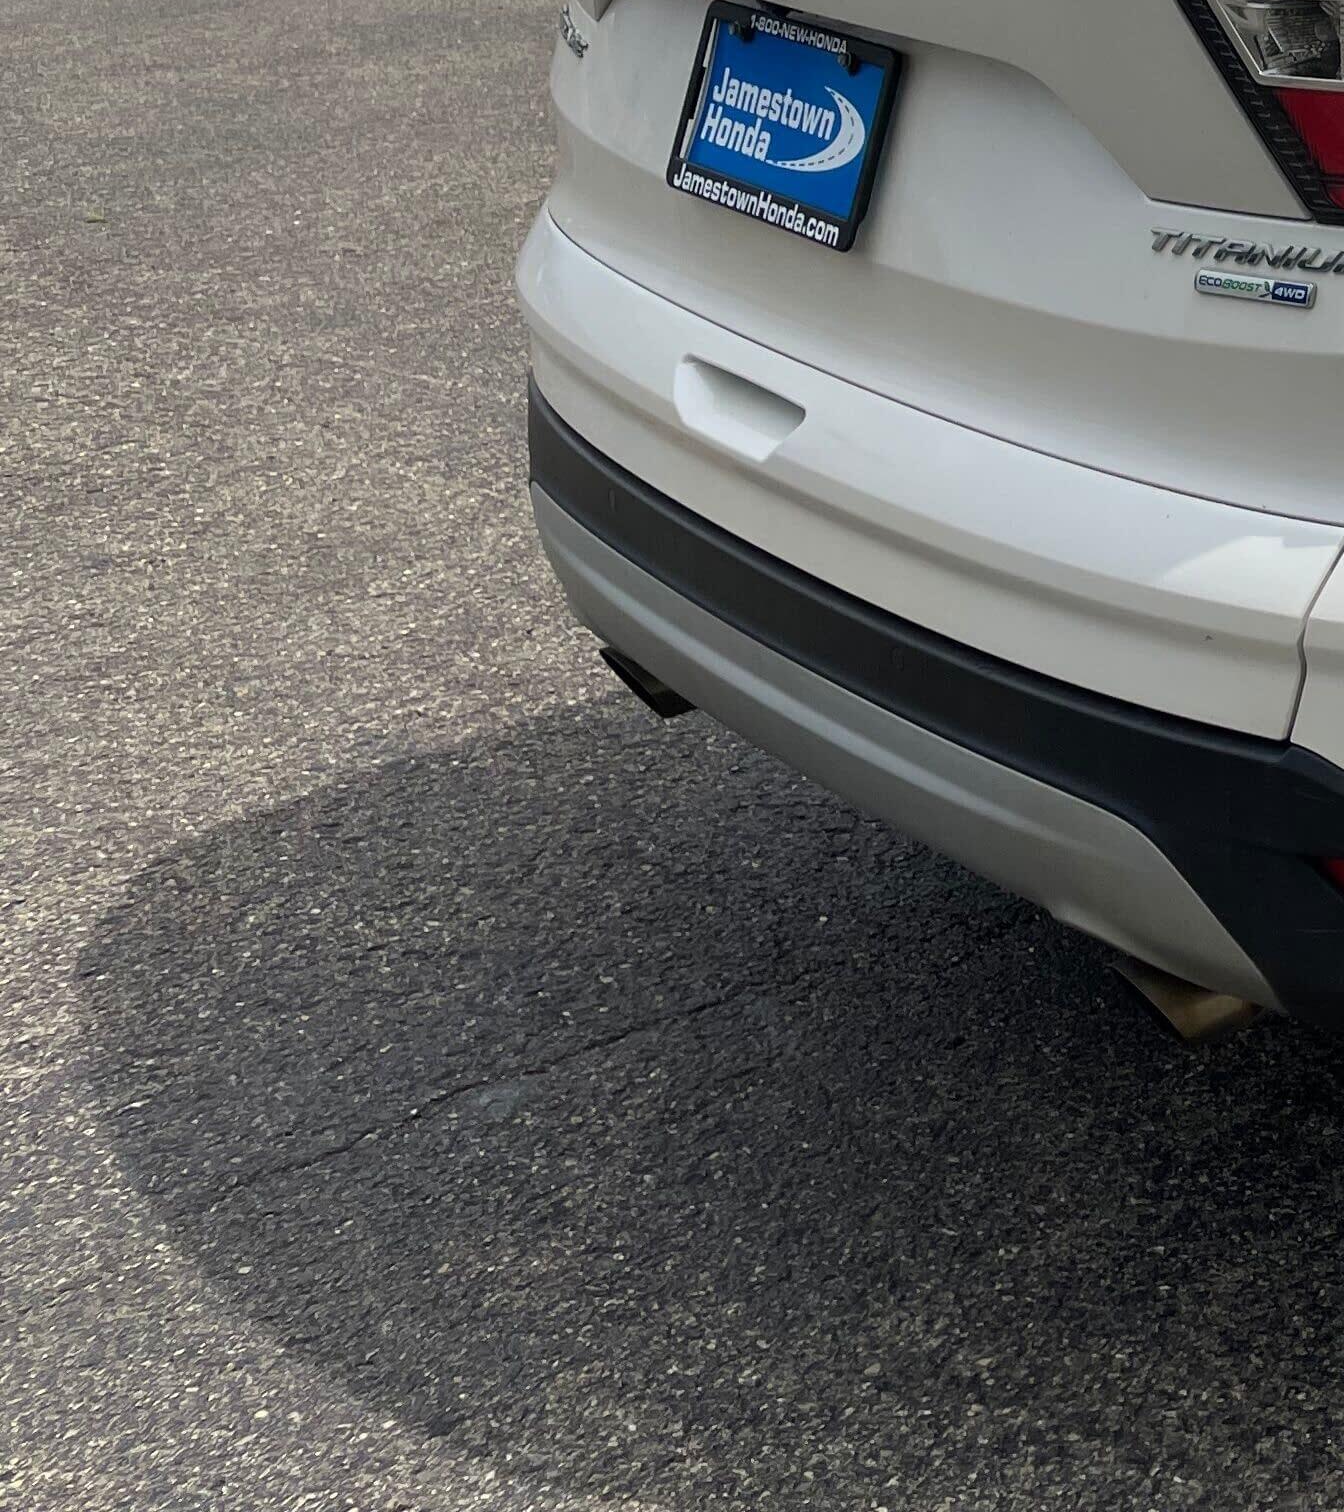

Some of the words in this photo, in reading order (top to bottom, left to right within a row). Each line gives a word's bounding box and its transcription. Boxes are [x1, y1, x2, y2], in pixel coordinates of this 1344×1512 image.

[750, 14, 848, 54] 1-800-NEW-HONDA
[700, 103, 771, 162] Honda
[712, 67, 836, 141] Jamestown
[673, 163, 840, 246] JamestownHonda.com
[1199, 275, 1262, 292] ECOBOOST
[1275, 287, 1305, 300] 4WD
